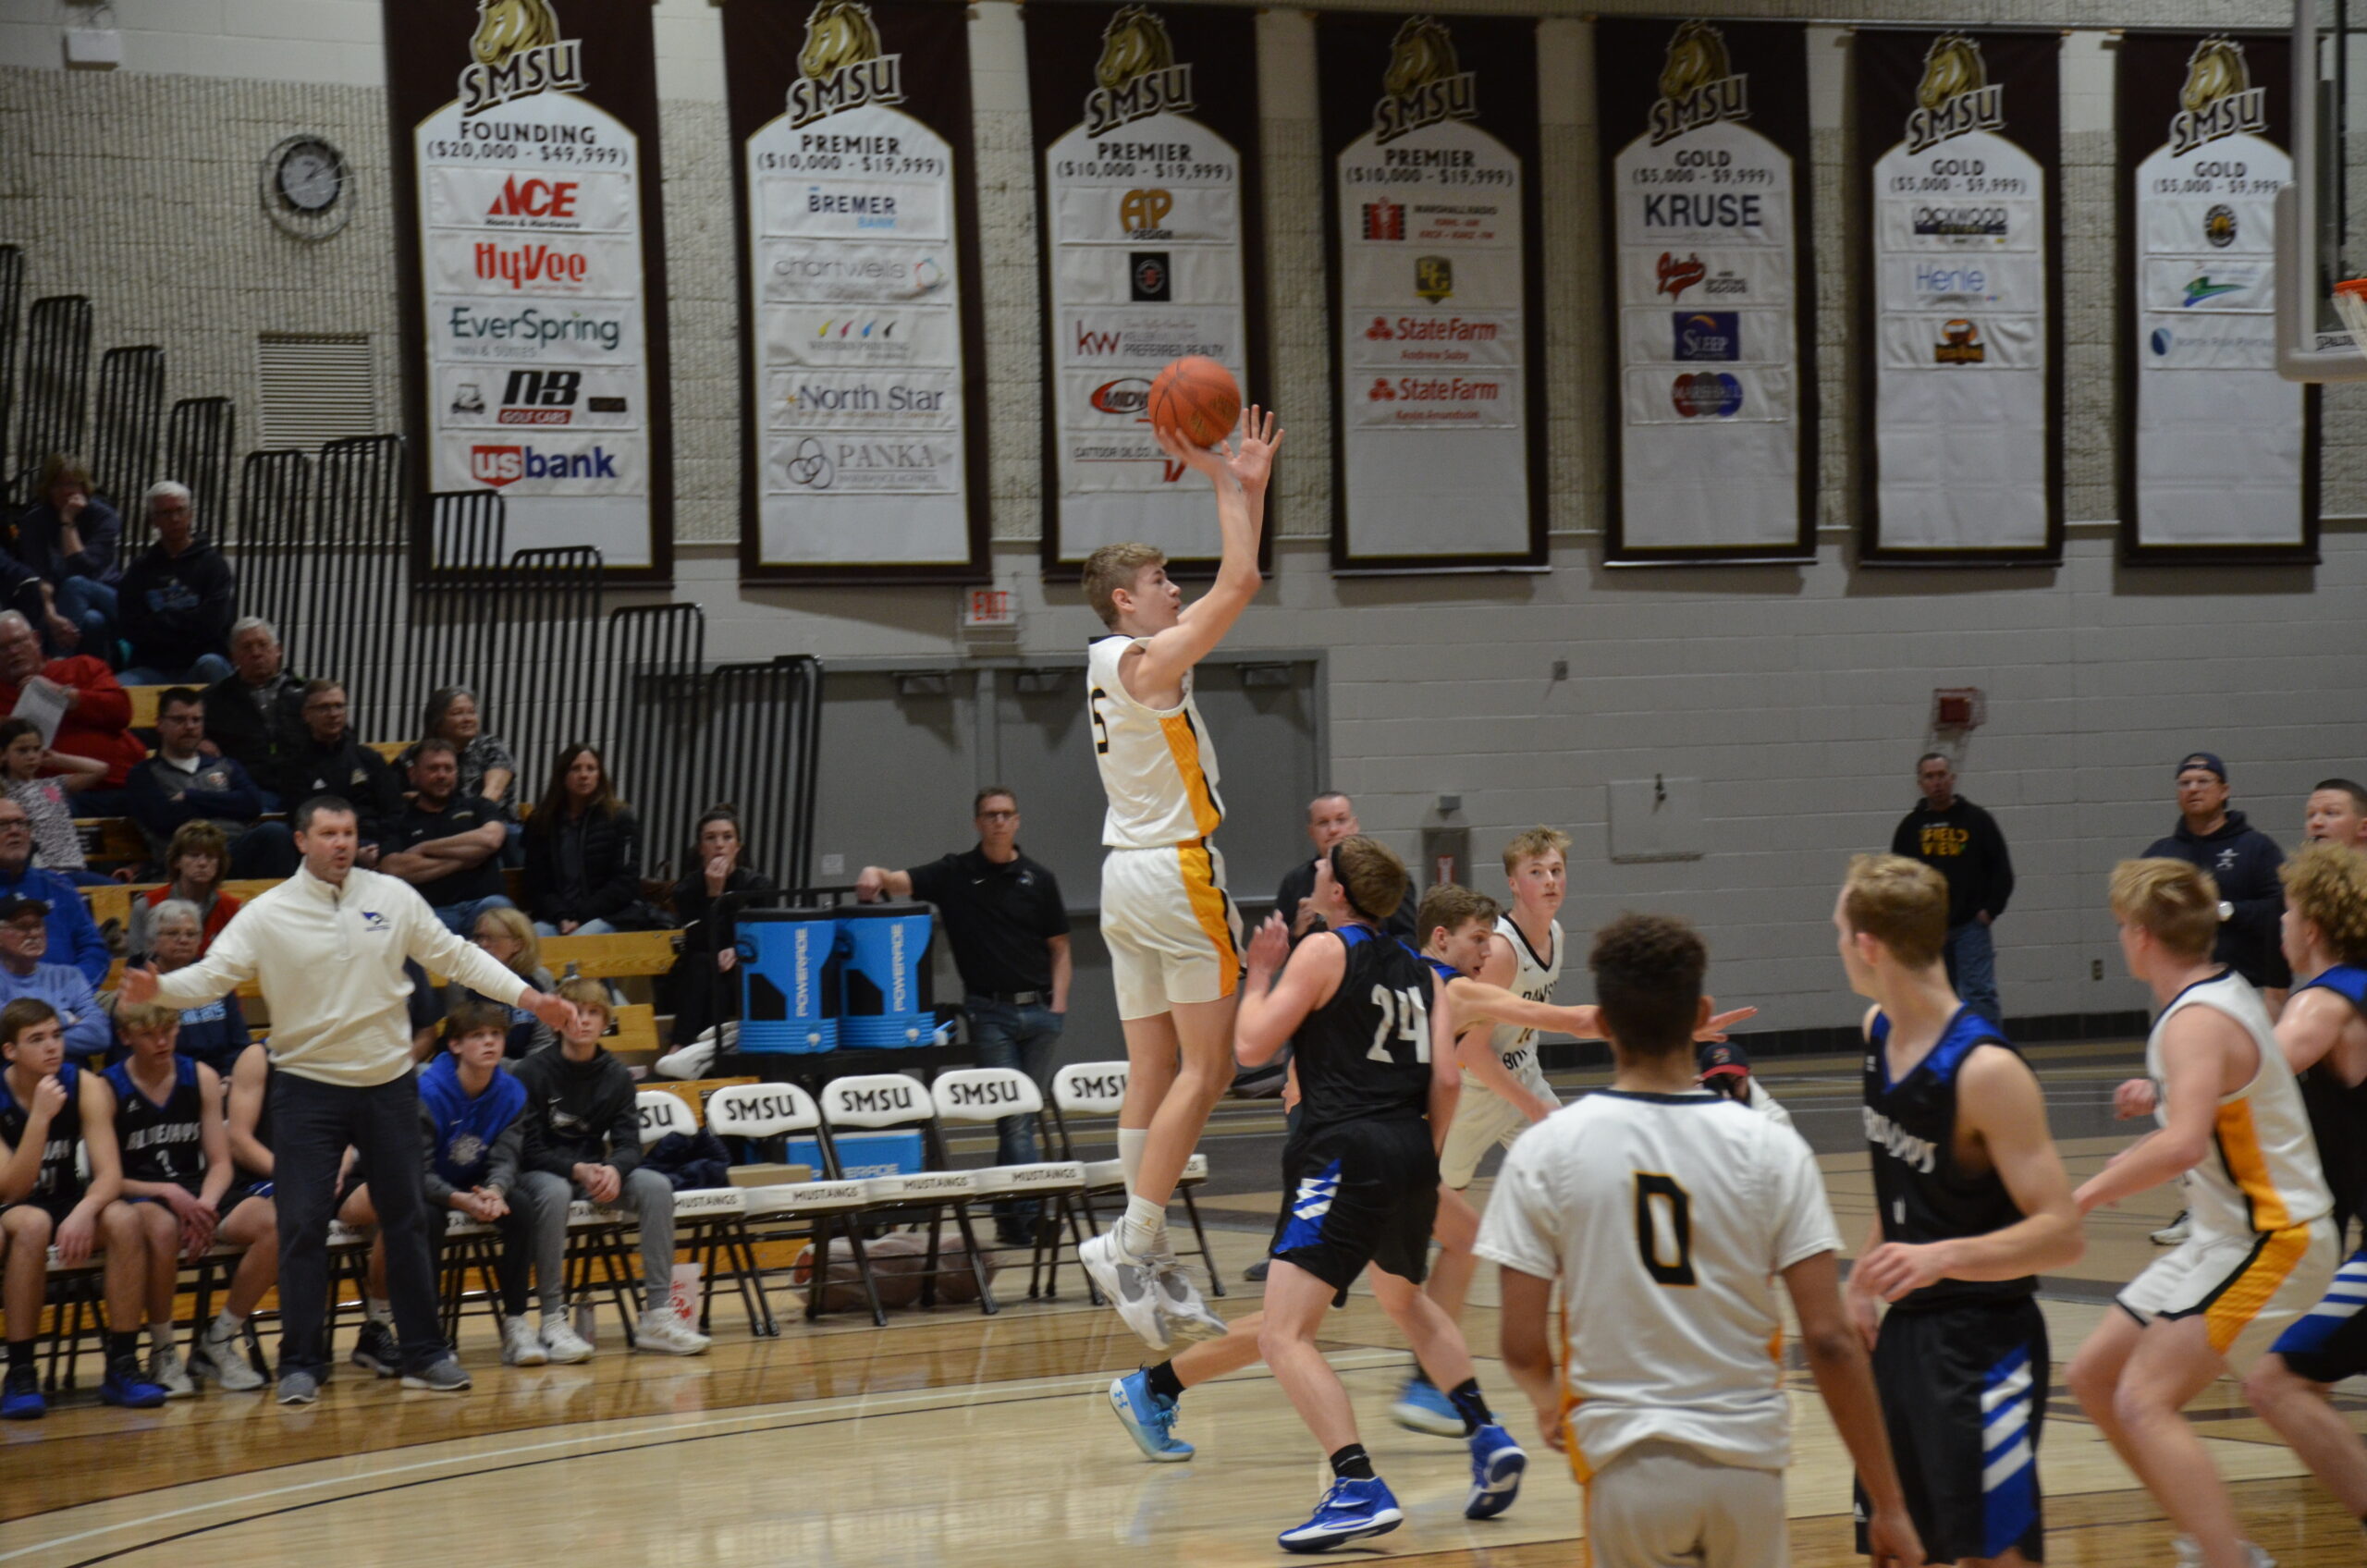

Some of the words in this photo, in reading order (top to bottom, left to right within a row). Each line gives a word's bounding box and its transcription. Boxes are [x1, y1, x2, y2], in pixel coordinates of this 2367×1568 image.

[460, 40, 584, 116] SMSU
[788, 55, 906, 129] SMSU
[1085, 64, 1196, 139] SMSU
[1374, 72, 1478, 146] SMSU
[1650, 75, 1750, 146] SMSU
[1907, 83, 2007, 155] SMSU
[460, 121, 596, 144] FOUNDING
[2170, 87, 2268, 158] SMSU
[426, 141, 518, 160] ($20,000
[541, 147, 629, 166] $49,999)
[802, 134, 901, 155] PREMIER
[1098, 142, 1192, 162] PREMIER
[757, 153, 841, 171] ($10,000
[863, 156, 944, 176] $19,999)
[1385, 149, 1475, 167] PREMIER
[1675, 150, 1731, 167] GOLD
[1932, 160, 1984, 176] GOLD
[2194, 162, 2247, 178] GOLD
[1057, 161, 1135, 178] ($10,000
[1155, 165, 1233, 181] $19,999)
[486, 173, 580, 217] ACE
[2227, 180, 2279, 193] $9,999
[808, 195, 897, 214] BREMER
[1645, 194, 1761, 227] KRUSE
[450, 307, 619, 349] EverSpring
[1076, 320, 1121, 356] kw
[1682, 329, 1729, 355] SLEEP
[799, 385, 877, 410] North
[888, 386, 944, 410] Star
[525, 447, 618, 478] bank
[837, 445, 936, 468] PANKA
[974, 591, 1008, 621] EXIT
[1919, 827, 1968, 842] FIELD
[1921, 842, 1959, 856] VIEW
[795, 927, 809, 1017] POWERADE
[890, 923, 907, 1011] POWERADE
[1367, 983, 1431, 1063] 24
[840, 1086, 914, 1111] SMSU
[950, 1080, 1021, 1105] SMSU
[1071, 1074, 1125, 1098] SMS
[640, 1104, 674, 1128] SU
[725, 1095, 798, 1121] SMSU
[903, 1176, 969, 1193] MUSTANGS
[1012, 1169, 1077, 1183] MUSTANGS
[793, 1186, 859, 1203] MUSTANGS
[1633, 1170, 1699, 1287] 0
